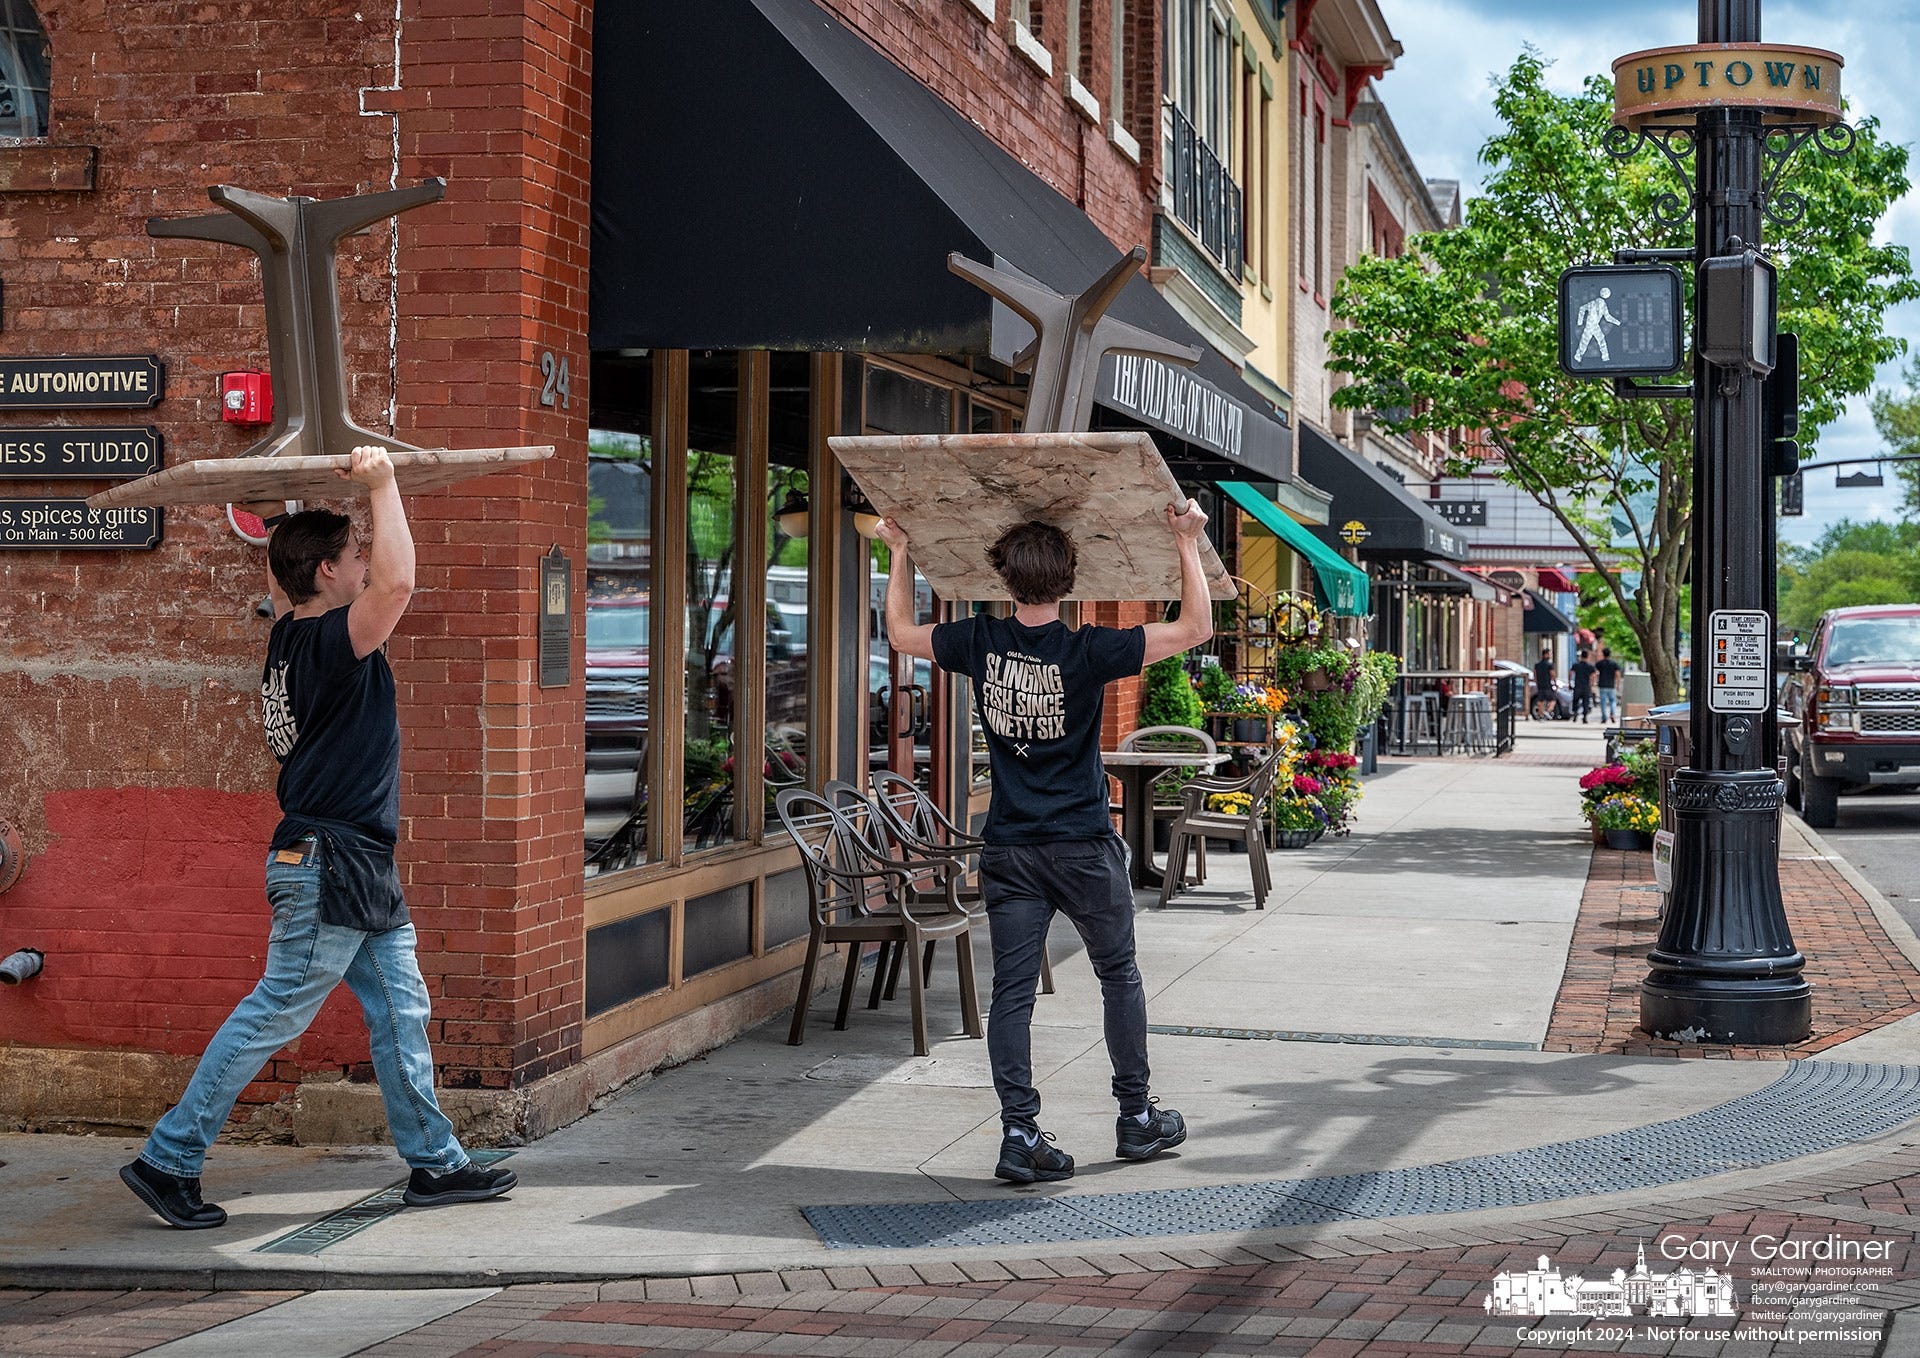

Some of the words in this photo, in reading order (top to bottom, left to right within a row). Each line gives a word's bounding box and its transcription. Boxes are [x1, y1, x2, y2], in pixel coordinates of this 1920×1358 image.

[1637, 61, 1821, 93] UPTOWN
[10, 371, 148, 393] AUTOMOTIVE
[541, 351, 569, 409] 24
[1112, 354, 1141, 410] THE
[1140, 358, 1166, 420] OLD
[1164, 368, 1188, 431] BAG
[1186, 379, 1202, 436] OF
[1200, 387, 1228, 449] NAILS
[1225, 402, 1243, 456] PUB
[0, 443, 46, 463] ESS
[62, 441, 149, 463] STUDIO
[0, 510, 16, 526] s,
[21, 505, 83, 528] spices
[87, 507, 101, 525] &
[105, 507, 148, 529] gifts
[6, 528, 24, 540] On
[28, 528, 58, 540] Main
[69, 528, 95, 540] 500
[99, 527, 124, 540] feet
[985, 652, 1065, 694] SLINGING
[982, 682, 1013, 714] FISH
[1015, 691, 1066, 716] SINCE
[983, 705, 1035, 739] NINETY
[1036, 715, 1067, 740] SIX
